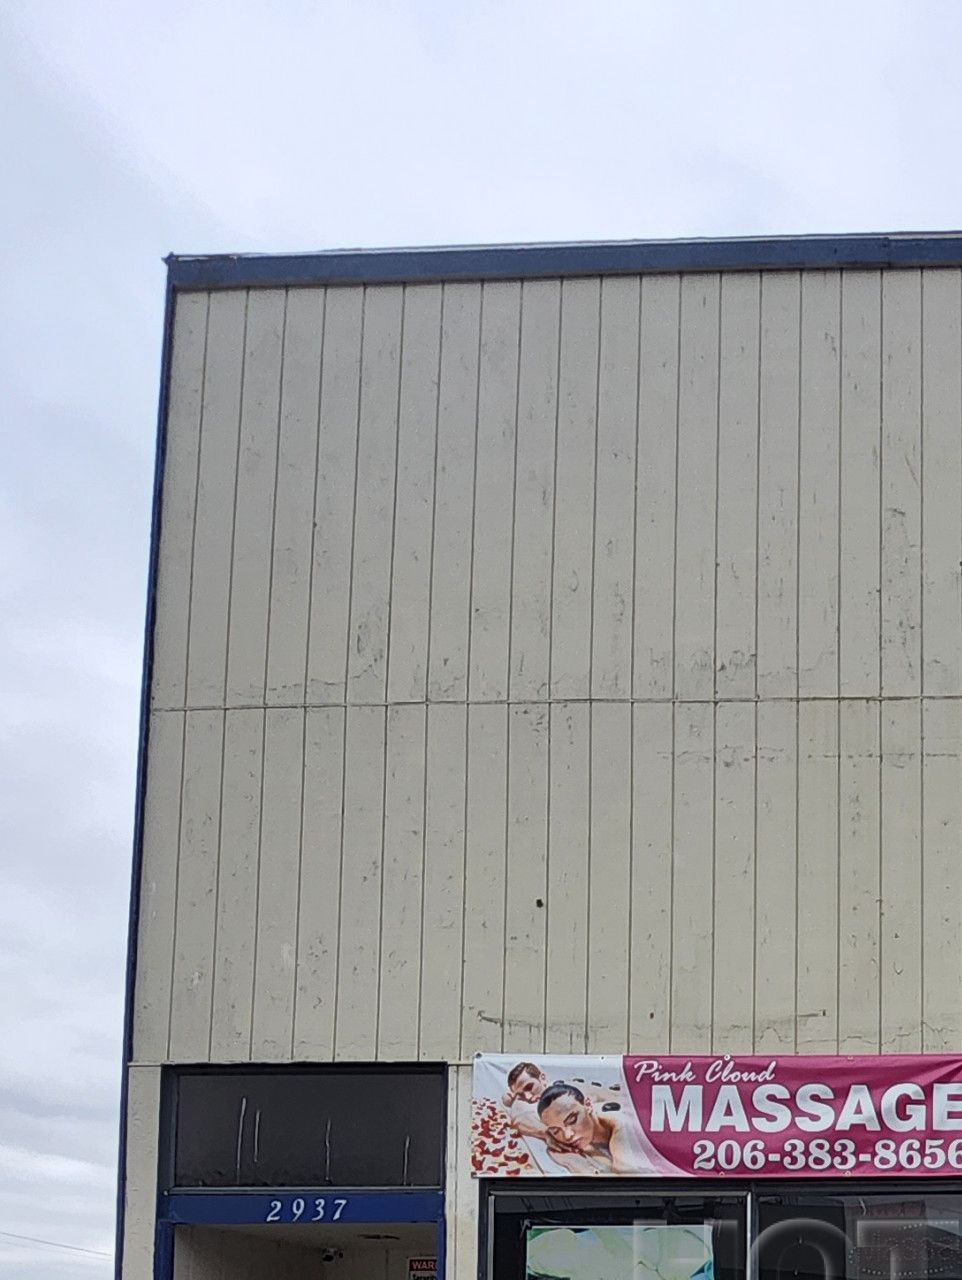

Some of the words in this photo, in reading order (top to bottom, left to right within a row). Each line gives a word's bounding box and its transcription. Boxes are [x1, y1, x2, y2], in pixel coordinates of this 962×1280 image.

[633, 1060, 697, 1083] Pink
[704, 1060, 777, 1083] Cloud
[265, 1198, 348, 1222] 2937
[412, 1261, 437, 1271] WAR
